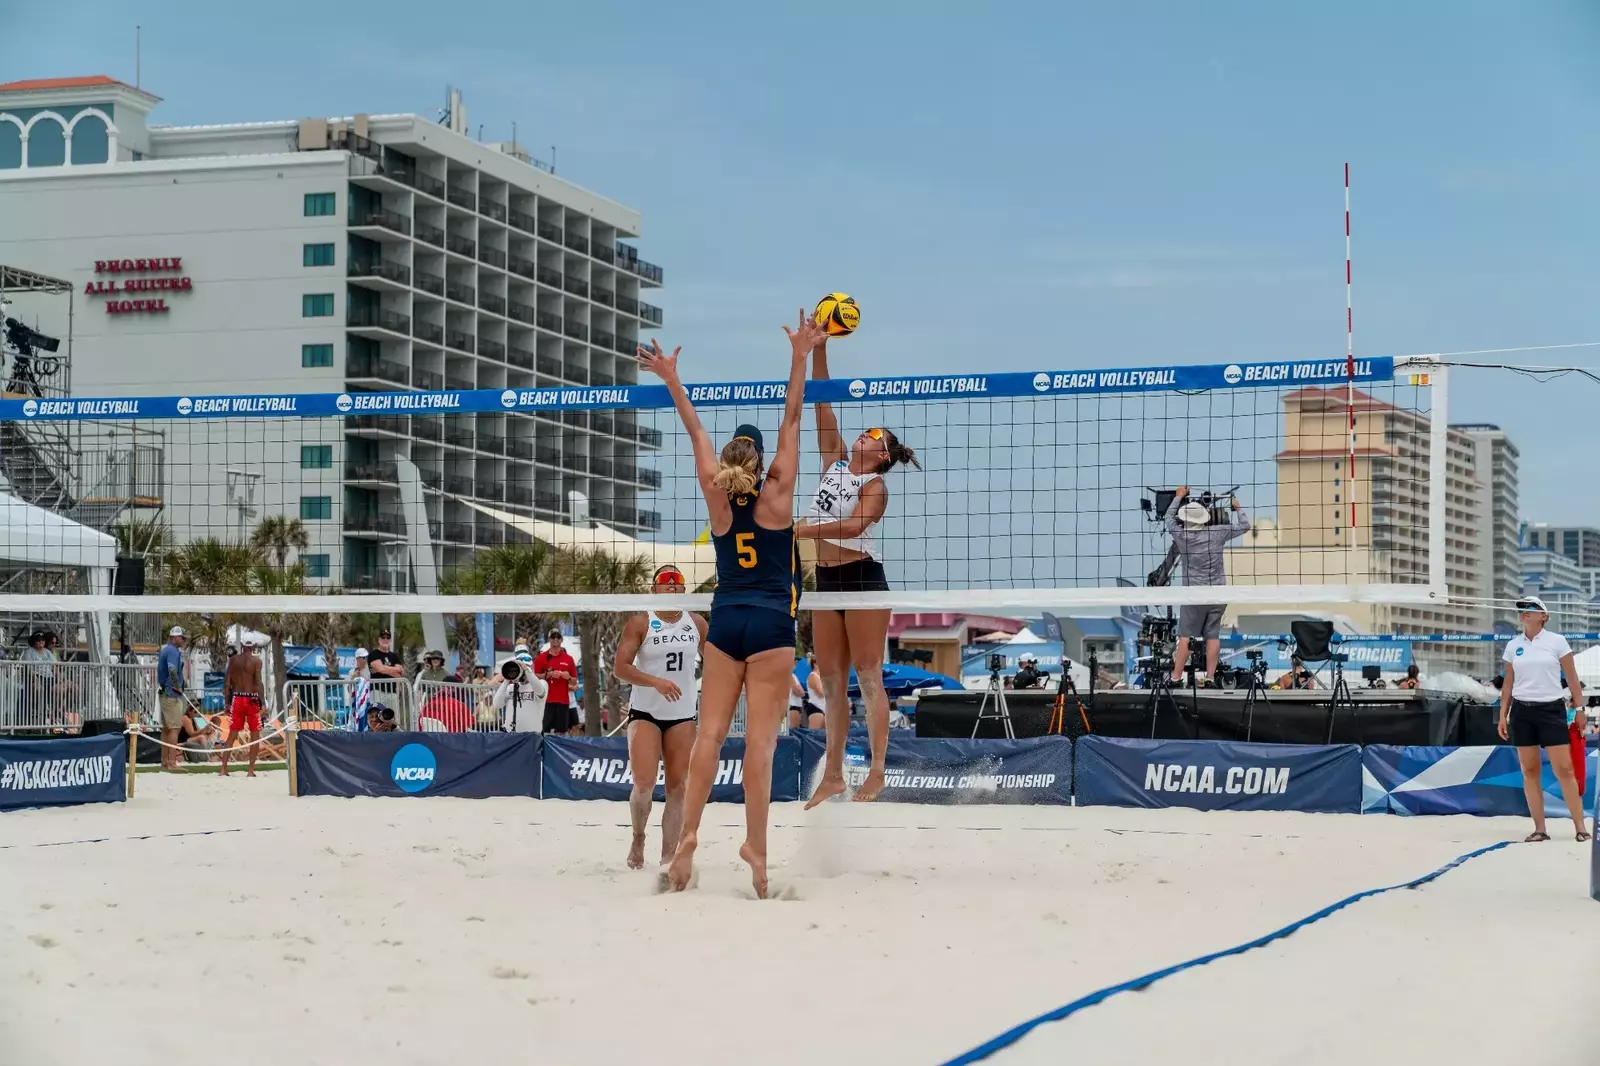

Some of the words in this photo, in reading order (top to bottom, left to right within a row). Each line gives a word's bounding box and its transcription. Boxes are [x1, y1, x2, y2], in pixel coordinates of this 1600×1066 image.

[94, 257, 182, 273] PHOENIX
[84, 281, 117, 294] ALL
[124, 277, 192, 293] SUITES
[106, 299, 169, 314] HOTEL
[1053, 373, 1096, 389] BEACH
[1100, 370, 1176, 387] VOLLEYBALL
[1245, 365, 1289, 381] BEACH
[691, 386, 731, 401] BEACH
[734, 385, 787, 400] VOLLEYB
[868, 381, 910, 395] BEACH
[914, 377, 988, 394] VOLLEYBALL
[194, 399, 230, 412] BEACH
[233, 398, 297, 412] VOLLEYBALL
[354, 396, 391, 410] BEACH
[394, 394, 460, 409] VOLLEYBALL
[519, 391, 558, 405] BEACH
[561, 389, 629, 404] VOLLEYBALL
[39, 401, 74, 415] BEACH
[77, 400, 139, 414] VOLLEYBALL
[735, 532, 758, 568] 5
[653, 634, 695, 645] BEACH
[666, 651, 683, 671] 21
[0, 756, 112, 790] #NCAABEACHVB
[395, 767, 434, 780] NCAA
[1144, 763, 1290, 794] NCAA.COM
[885, 775, 954, 788] VOLLEYBALL
[957, 774, 1055, 789] CHPIONSHIP
